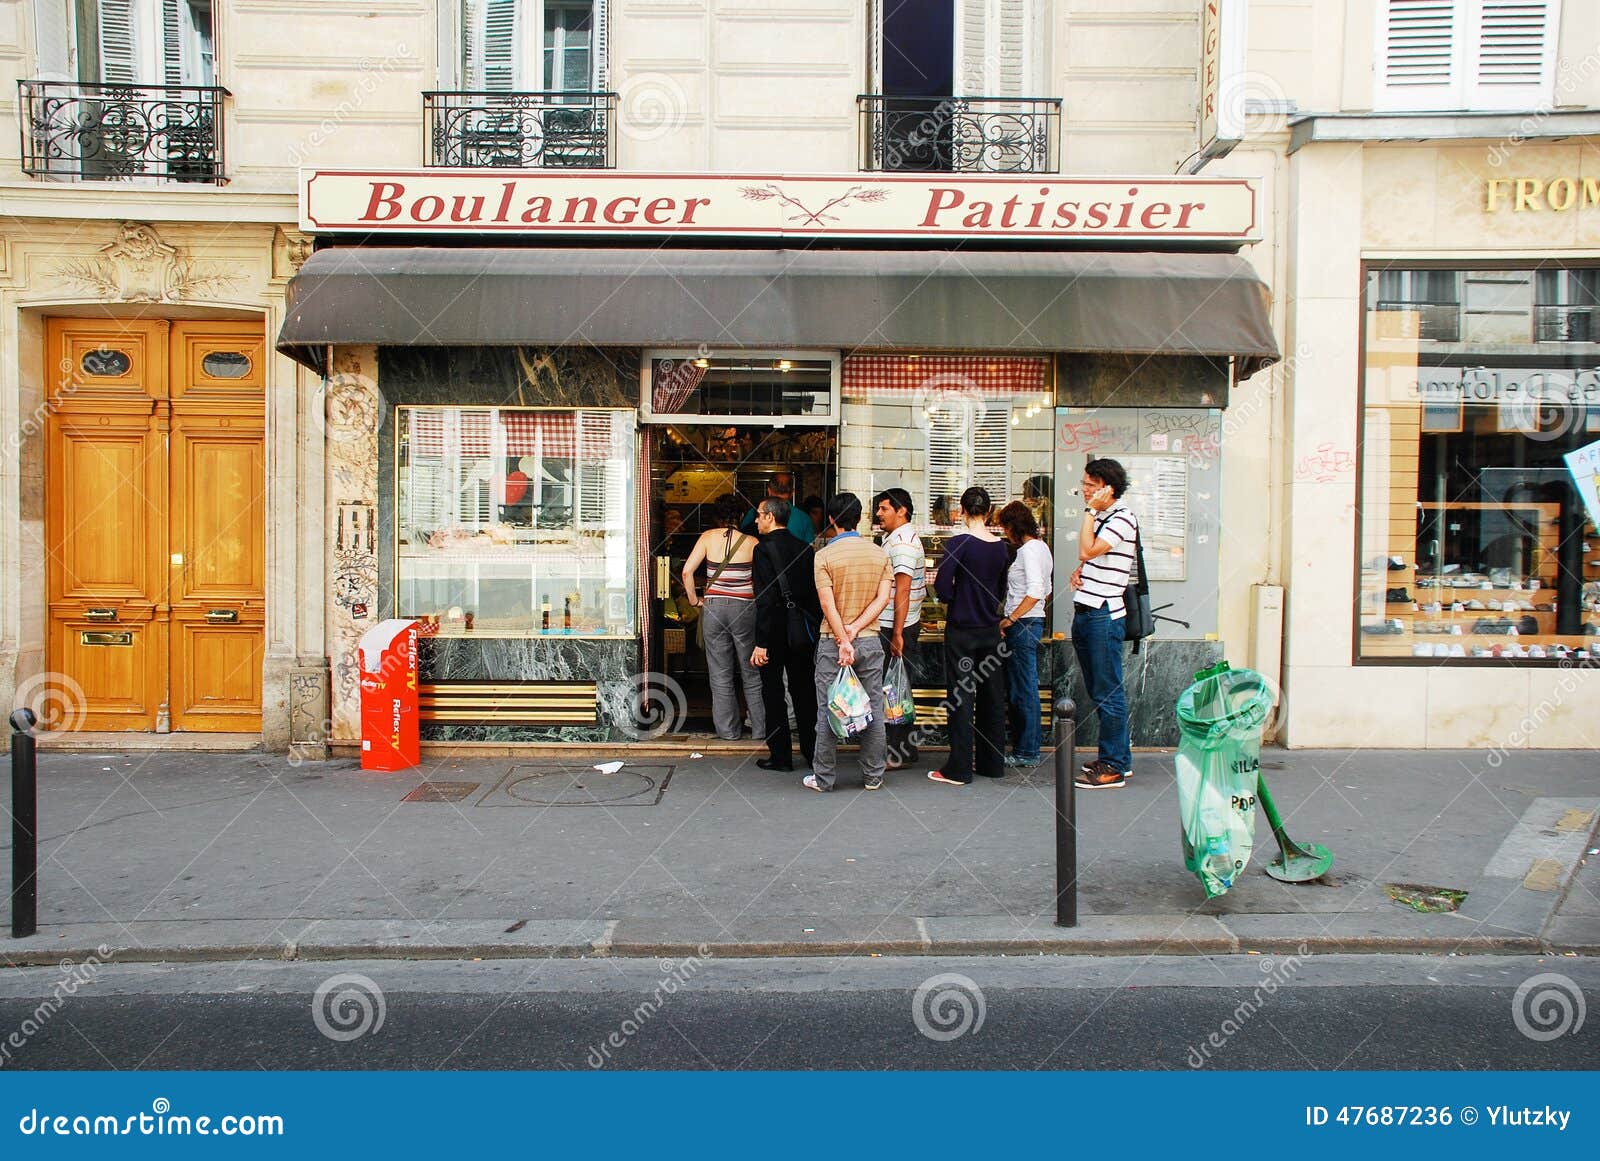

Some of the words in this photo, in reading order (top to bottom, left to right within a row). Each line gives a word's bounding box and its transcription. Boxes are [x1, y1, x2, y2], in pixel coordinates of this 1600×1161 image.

[358, 181, 711, 225] Boulanger
[917, 187, 1206, 229] Patissier
[408, 628, 417, 669] Reflex
[406, 670, 417, 691] TV
[393, 698, 401, 733] Reflex
[391, 734, 401, 751] TV
